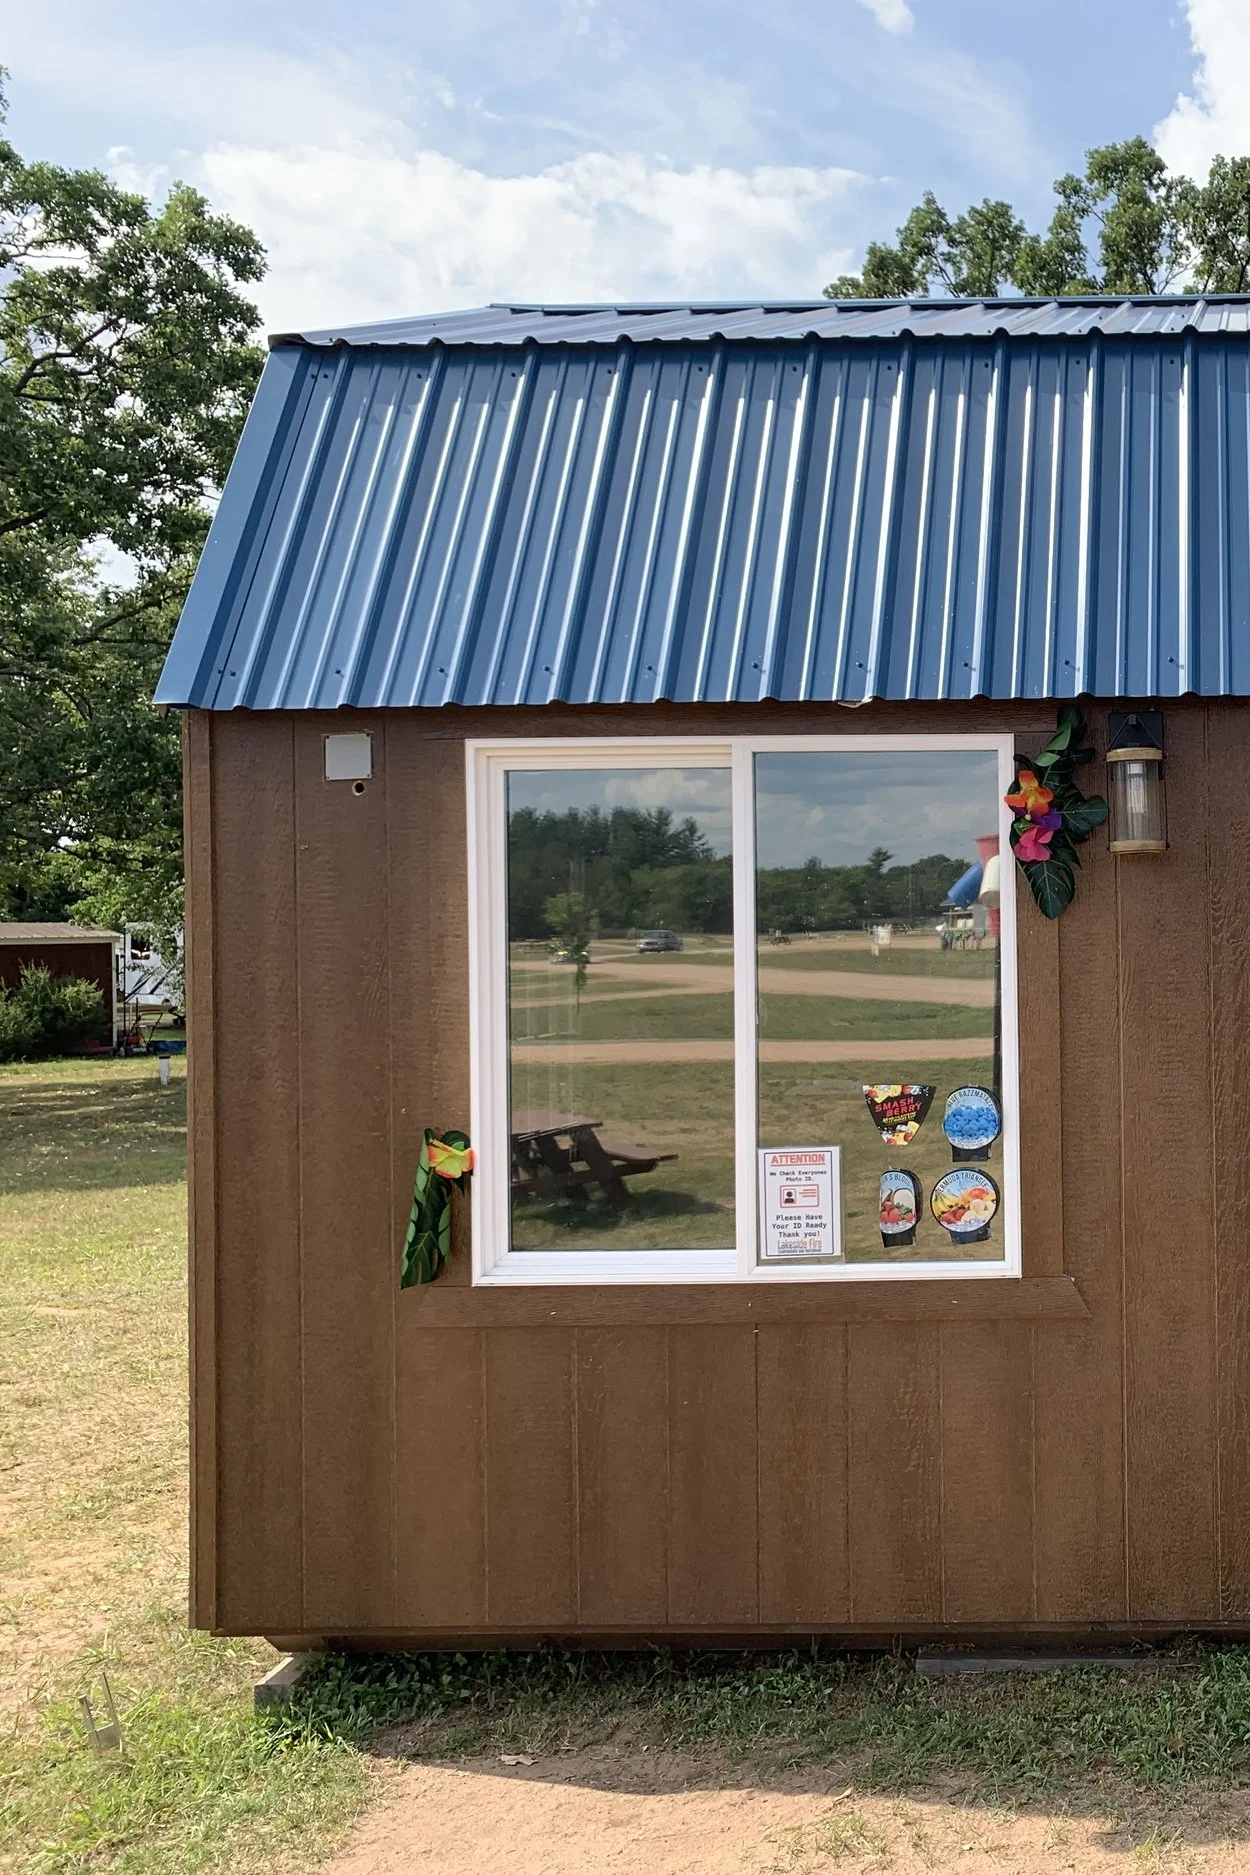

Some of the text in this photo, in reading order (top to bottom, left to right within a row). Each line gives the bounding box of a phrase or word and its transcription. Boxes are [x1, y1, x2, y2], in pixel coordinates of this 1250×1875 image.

[875, 1096, 914, 1113] SMASH
[886, 1100, 922, 1118] BERRY
[771, 1153, 825, 1164] ATTENTION
[961, 1172, 989, 1188] TRIANGLE
[805, 1221, 827, 1229] Ready
[804, 1230, 820, 1239] you!
[777, 1239, 823, 1250] Lakeside Fire
